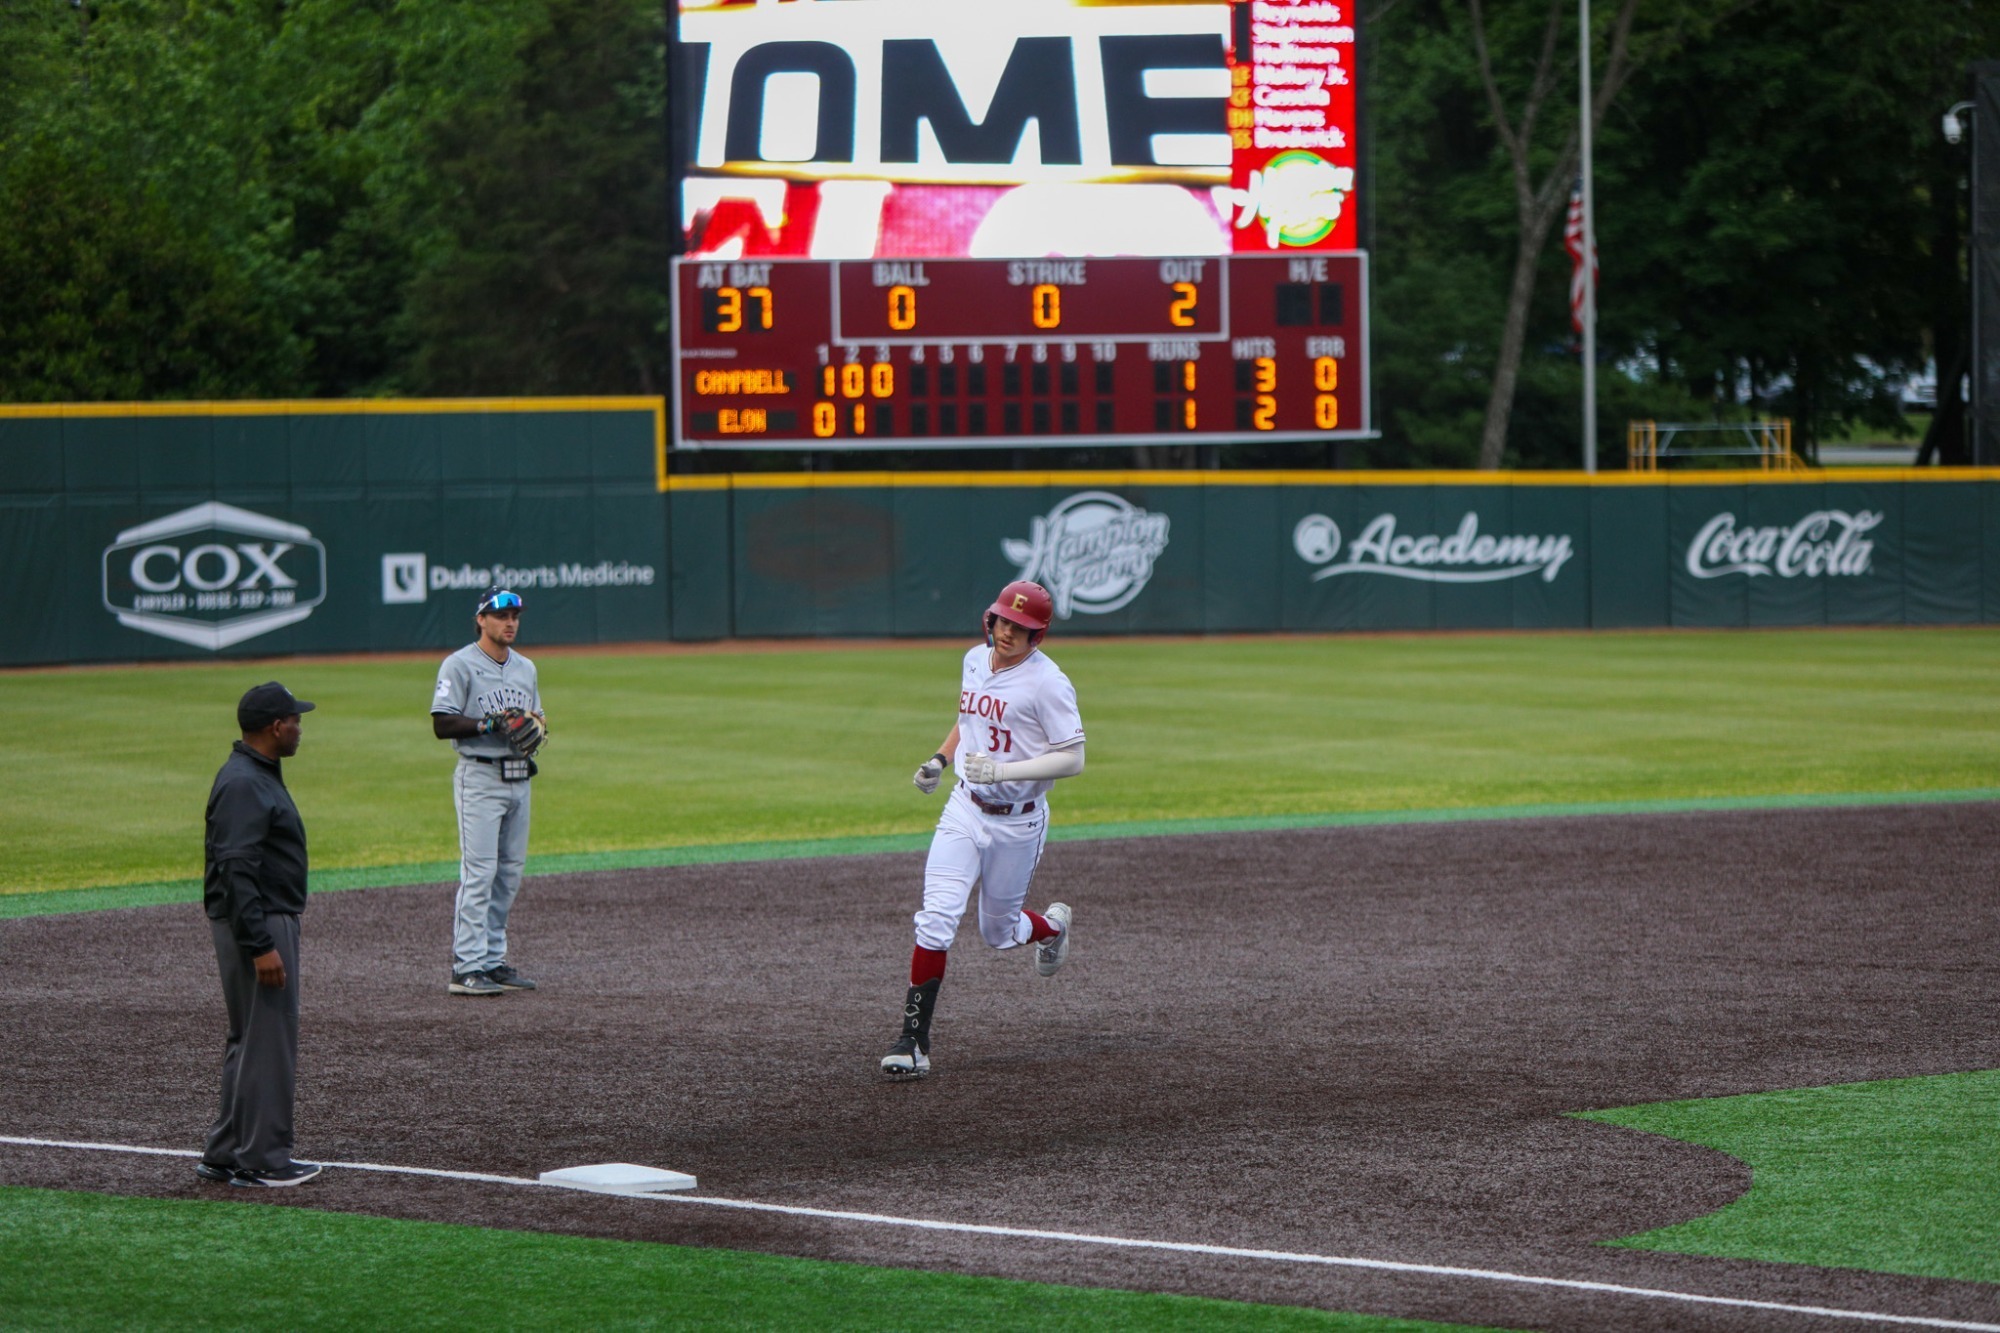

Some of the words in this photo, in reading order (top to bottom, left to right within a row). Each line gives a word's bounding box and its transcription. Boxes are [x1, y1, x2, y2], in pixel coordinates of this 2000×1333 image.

[698, 264, 729, 287] AT
[730, 263, 773, 287] BAT
[872, 262, 930, 286] BALL
[1008, 261, 1087, 286] STRIKE
[1160, 260, 1206, 284] OUT
[1289, 258, 1329, 282] H/E
[717, 287, 773, 332] 37
[888, 286, 916, 330] 0
[1032, 284, 1061, 328] 0
[1169, 282, 1197, 326] 2
[1148, 338, 1200, 360] RUNS
[1232, 337, 1276, 359] HITS
[1306, 336, 1346, 358] ERR
[695, 369, 790, 395] CAMPBELL
[1184, 360, 1196, 391] 1
[1255, 357, 1277, 392] 3
[1314, 356, 1337, 391] 0
[718, 409, 767, 433] ELON
[1184, 397, 1196, 430] 1
[1254, 394, 1277, 430] 2
[1314, 394, 1338, 430] 0
[1005, 507, 1172, 592] Hampton
[1348, 511, 1574, 583] Academy
[130, 543, 298, 593] COX
[430, 563, 491, 590] Duke
[492, 563, 558, 590] Sports
[558, 560, 655, 588] Medicine
[1010, 593, 1028, 613] E
[959, 691, 1008, 723] ELON
[988, 726, 1012, 753] 37
